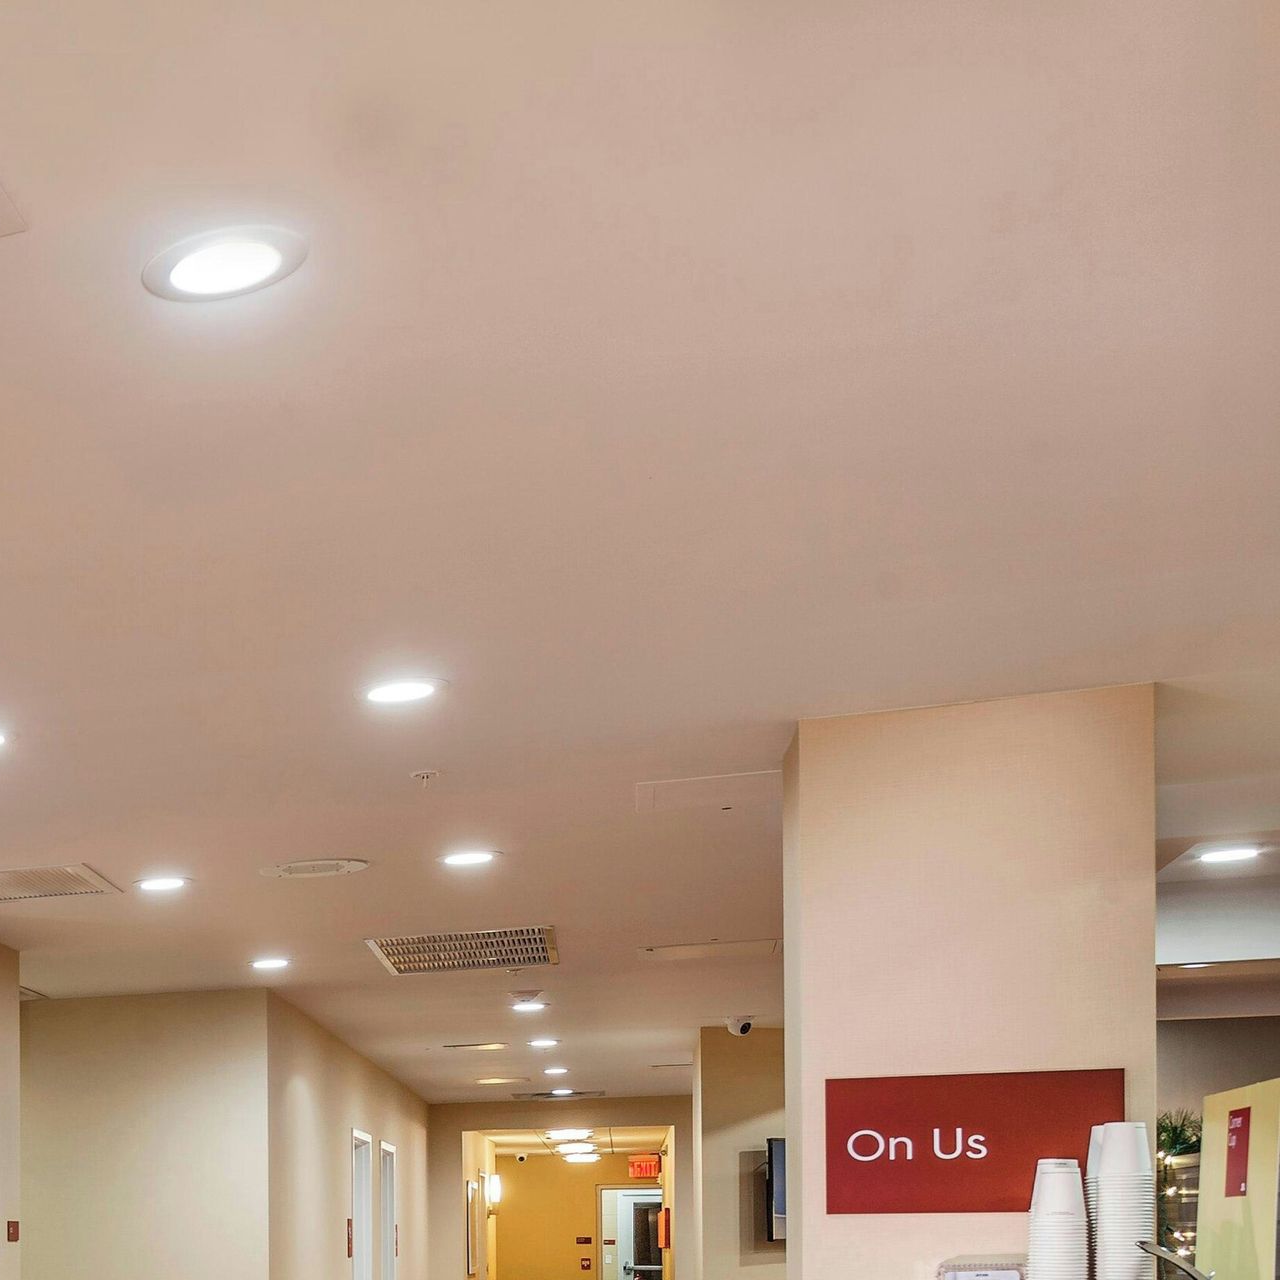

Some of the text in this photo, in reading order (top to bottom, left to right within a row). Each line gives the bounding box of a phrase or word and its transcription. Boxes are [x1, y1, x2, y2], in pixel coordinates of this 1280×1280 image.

[847, 1127, 988, 1162] On Us
[634, 1161, 656, 1177] EXIT
